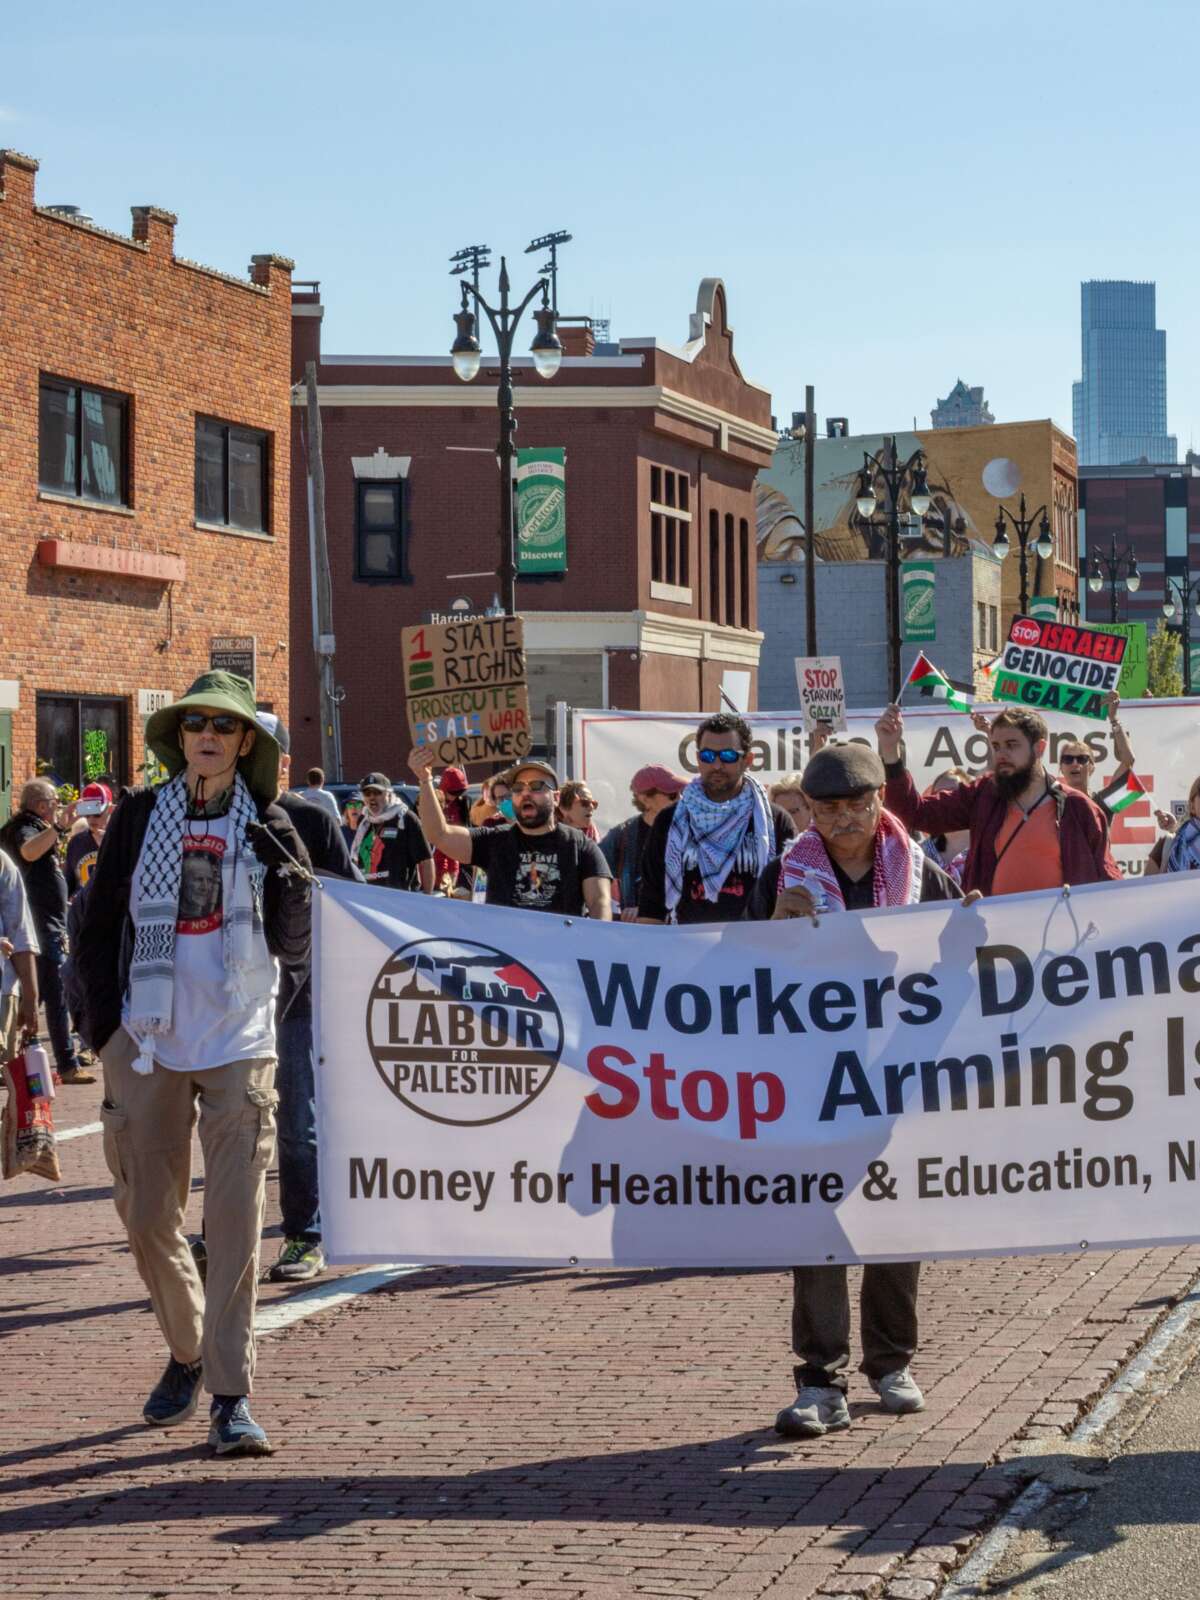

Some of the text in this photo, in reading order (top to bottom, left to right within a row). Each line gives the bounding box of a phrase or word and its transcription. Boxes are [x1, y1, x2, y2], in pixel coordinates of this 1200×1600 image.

[520, 551, 564, 560] Discover
[431, 612, 485, 625] Harrison
[442, 617, 519, 653] STATE
[212, 638, 253, 650] ZONE 206
[1013, 626, 1039, 641] STOP
[1040, 623, 1125, 663] ISRAELI
[443, 647, 525, 686] RIGHTS
[804, 668, 838, 689] STOP
[1004, 646, 1118, 690] GENOCIDE
[411, 687, 517, 723] PROSECUTE
[802, 687, 844, 704] STARVING
[809, 703, 841, 719] GAZA!
[1001, 679, 1103, 716] IN GAZA
[489, 708, 526, 732] WAR
[438, 731, 529, 764] CRIMES
[576, 959, 943, 1036] Workers
[388, 1001, 545, 1048] LABOR
[451, 1050, 479, 1061] FOR
[393, 1063, 539, 1096] PALESTINE
[583, 1044, 786, 1140] Stop
[818, 1032, 1134, 1122] Arming
[348, 1156, 495, 1212] Money
[510, 1160, 575, 1204] for
[592, 1163, 845, 1207] Healthcare
[862, 1161, 898, 1201] &
[918, 1147, 1152, 1199] Education,
